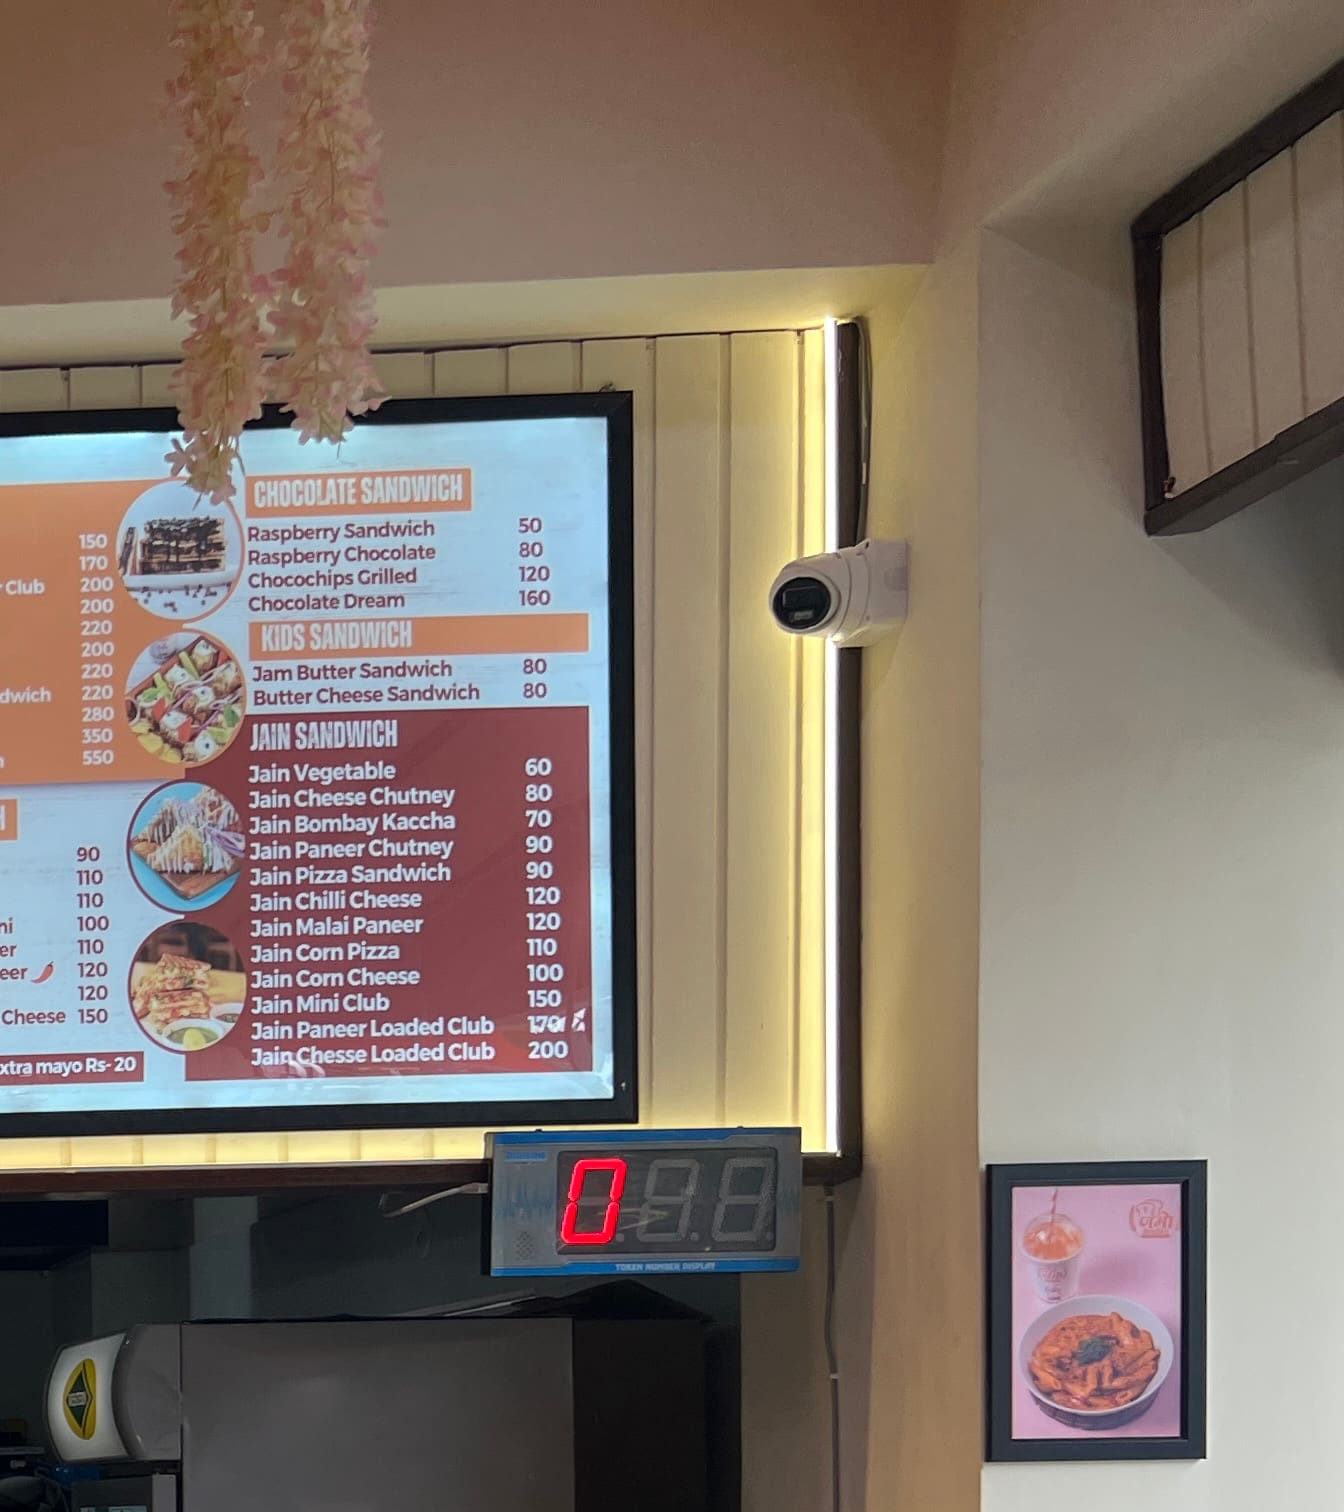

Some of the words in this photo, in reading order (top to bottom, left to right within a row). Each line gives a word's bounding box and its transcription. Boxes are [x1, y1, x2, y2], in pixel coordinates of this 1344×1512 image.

[254, 477, 357, 508] CHOCOLATE
[360, 473, 463, 505] SANDWICH
[79, 533, 109, 549] 150
[248, 593, 340, 612] Chocolate
[343, 593, 405, 609] Dream
[518, 589, 551, 607] 160
[261, 623, 305, 652] KIDS
[309, 620, 413, 650] SANDWICH
[81, 641, 115, 658] 200
[252, 665, 293, 682] Jam
[297, 664, 357, 681] Butter
[359, 659, 453, 679] Sandwich
[522, 658, 548, 675] 80
[81, 684, 114, 701] 220
[249, 722, 291, 751] JAIN
[295, 719, 398, 750] SANDWICH
[248, 763, 291, 783] Jain
[293, 760, 396, 786] Vegetable
[525, 757, 552, 777] 60
[76, 846, 101, 863] 90
[76, 892, 104, 909] 110
[251, 994, 293, 1015] Jain
[296, 992, 340, 1013] Mini
[342, 992, 390, 1012] Club
[527, 989, 562, 1008] 150
